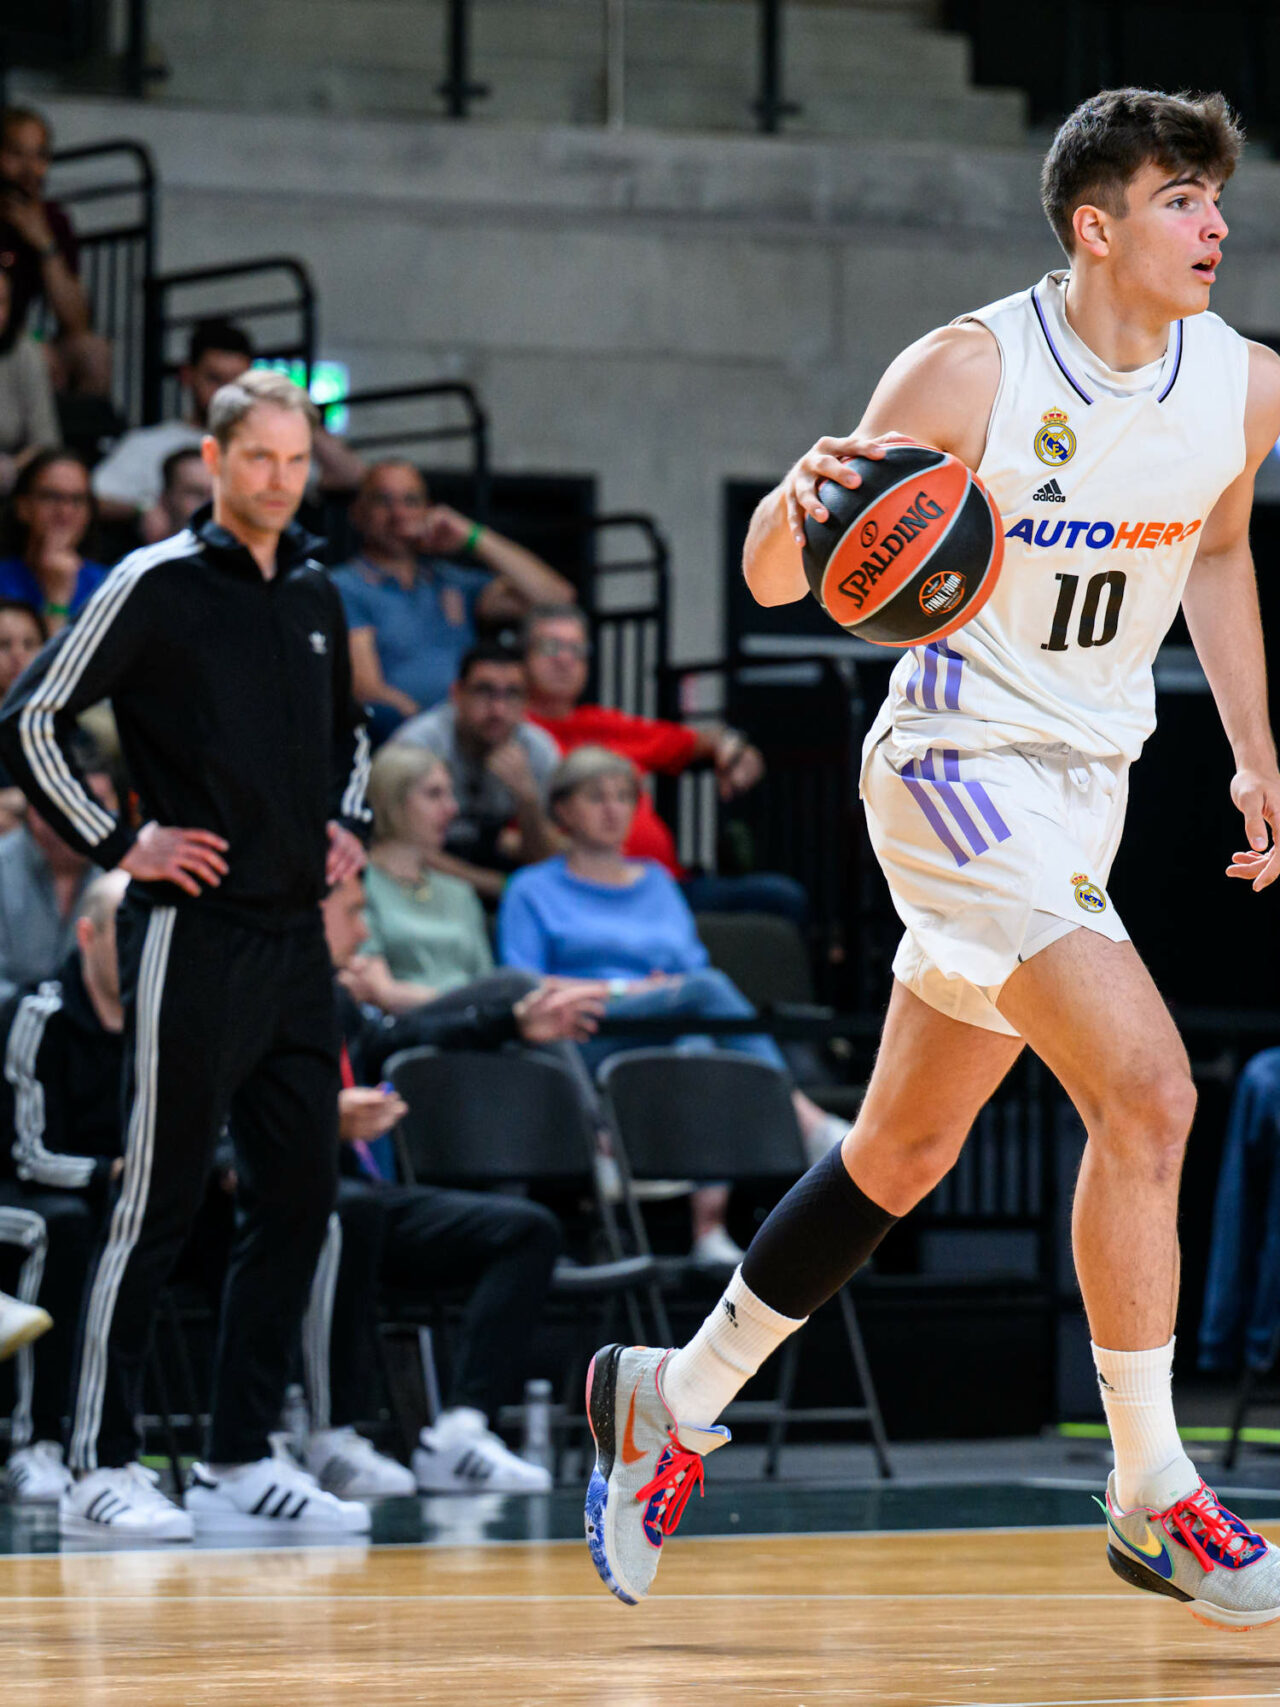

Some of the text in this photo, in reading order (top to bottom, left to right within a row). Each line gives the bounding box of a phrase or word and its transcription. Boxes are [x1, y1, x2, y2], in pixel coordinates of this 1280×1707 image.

[1032, 492, 1066, 503] adidas
[838, 491, 945, 610] SPALDING
[1004, 518, 1202, 550] AUTOHERO
[925, 591, 950, 611] FINAL
[940, 574, 962, 597] FOUR
[1040, 570, 1127, 652] 10
